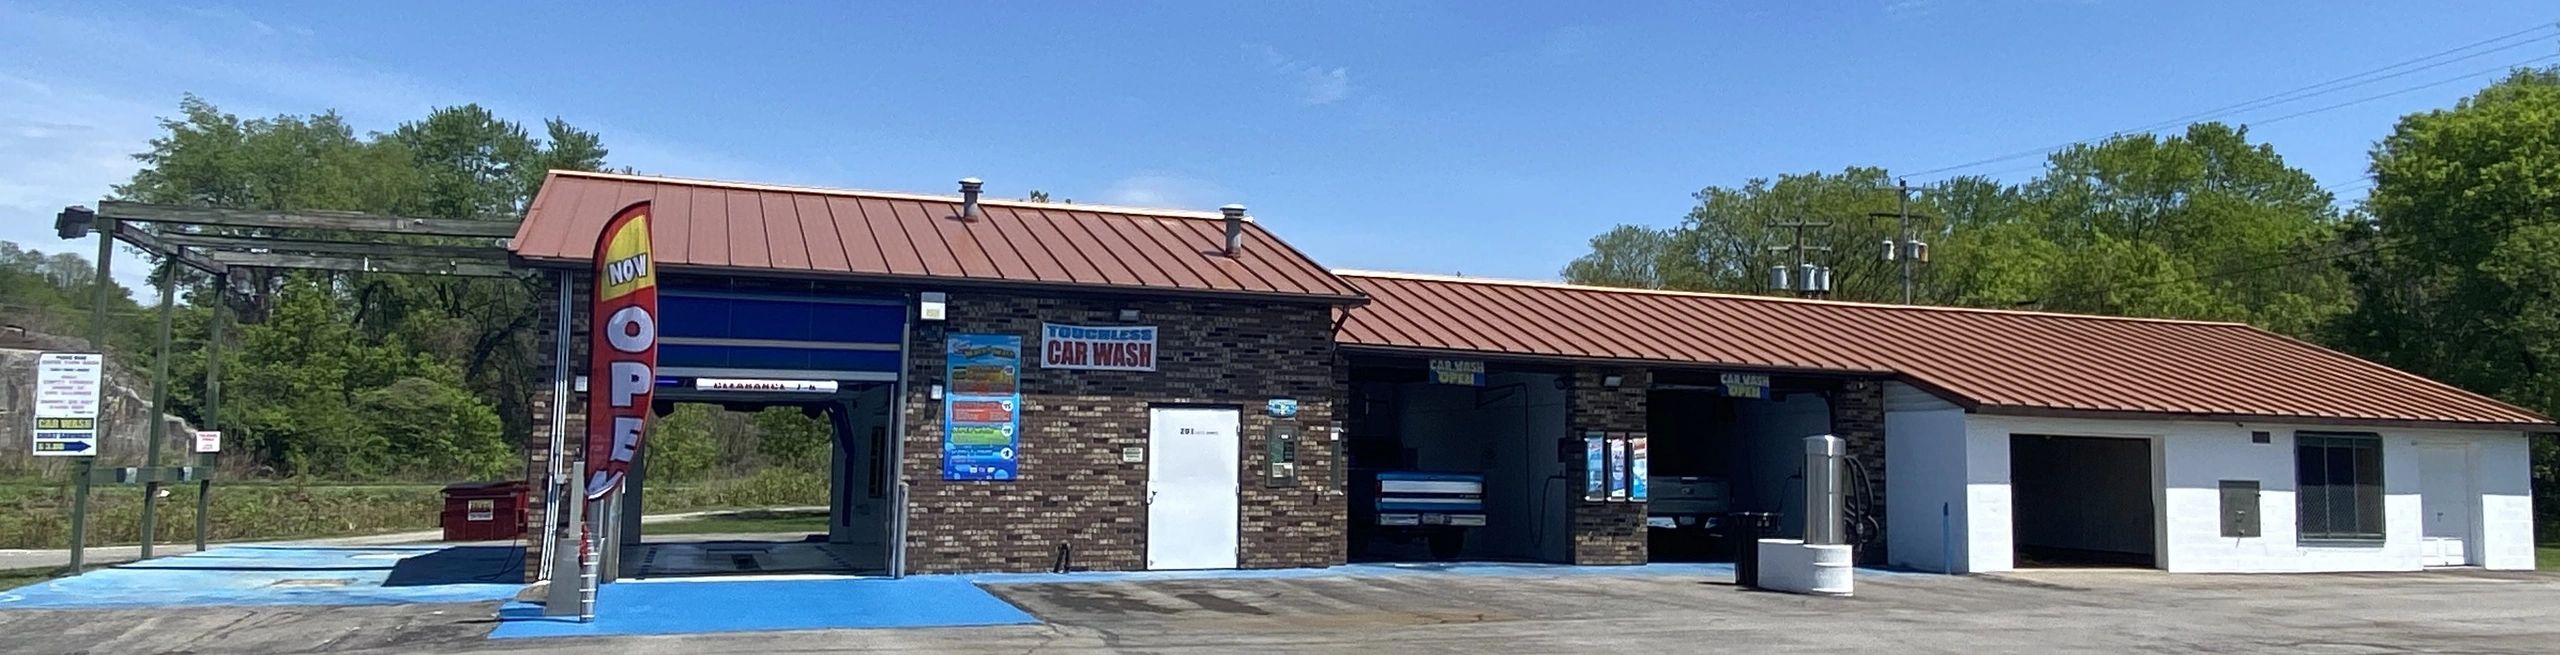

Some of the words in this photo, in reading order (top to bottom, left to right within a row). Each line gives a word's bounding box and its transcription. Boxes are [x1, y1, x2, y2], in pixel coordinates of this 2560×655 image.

[1046, 325, 1153, 341] TOUCHLESS
[1047, 339, 1088, 366] CAR
[1093, 341, 1152, 368] WASH
[1430, 360, 1451, 370] CAR
[1454, 360, 1485, 373] WASH
[1438, 371, 1474, 385] OPEN
[1720, 374, 1740, 384] CAR
[1742, 375, 1769, 387] WASH
[1728, 384, 1760, 398] OPEN
[38, 419, 59, 429] CAR
[60, 419, 92, 429] WASH
